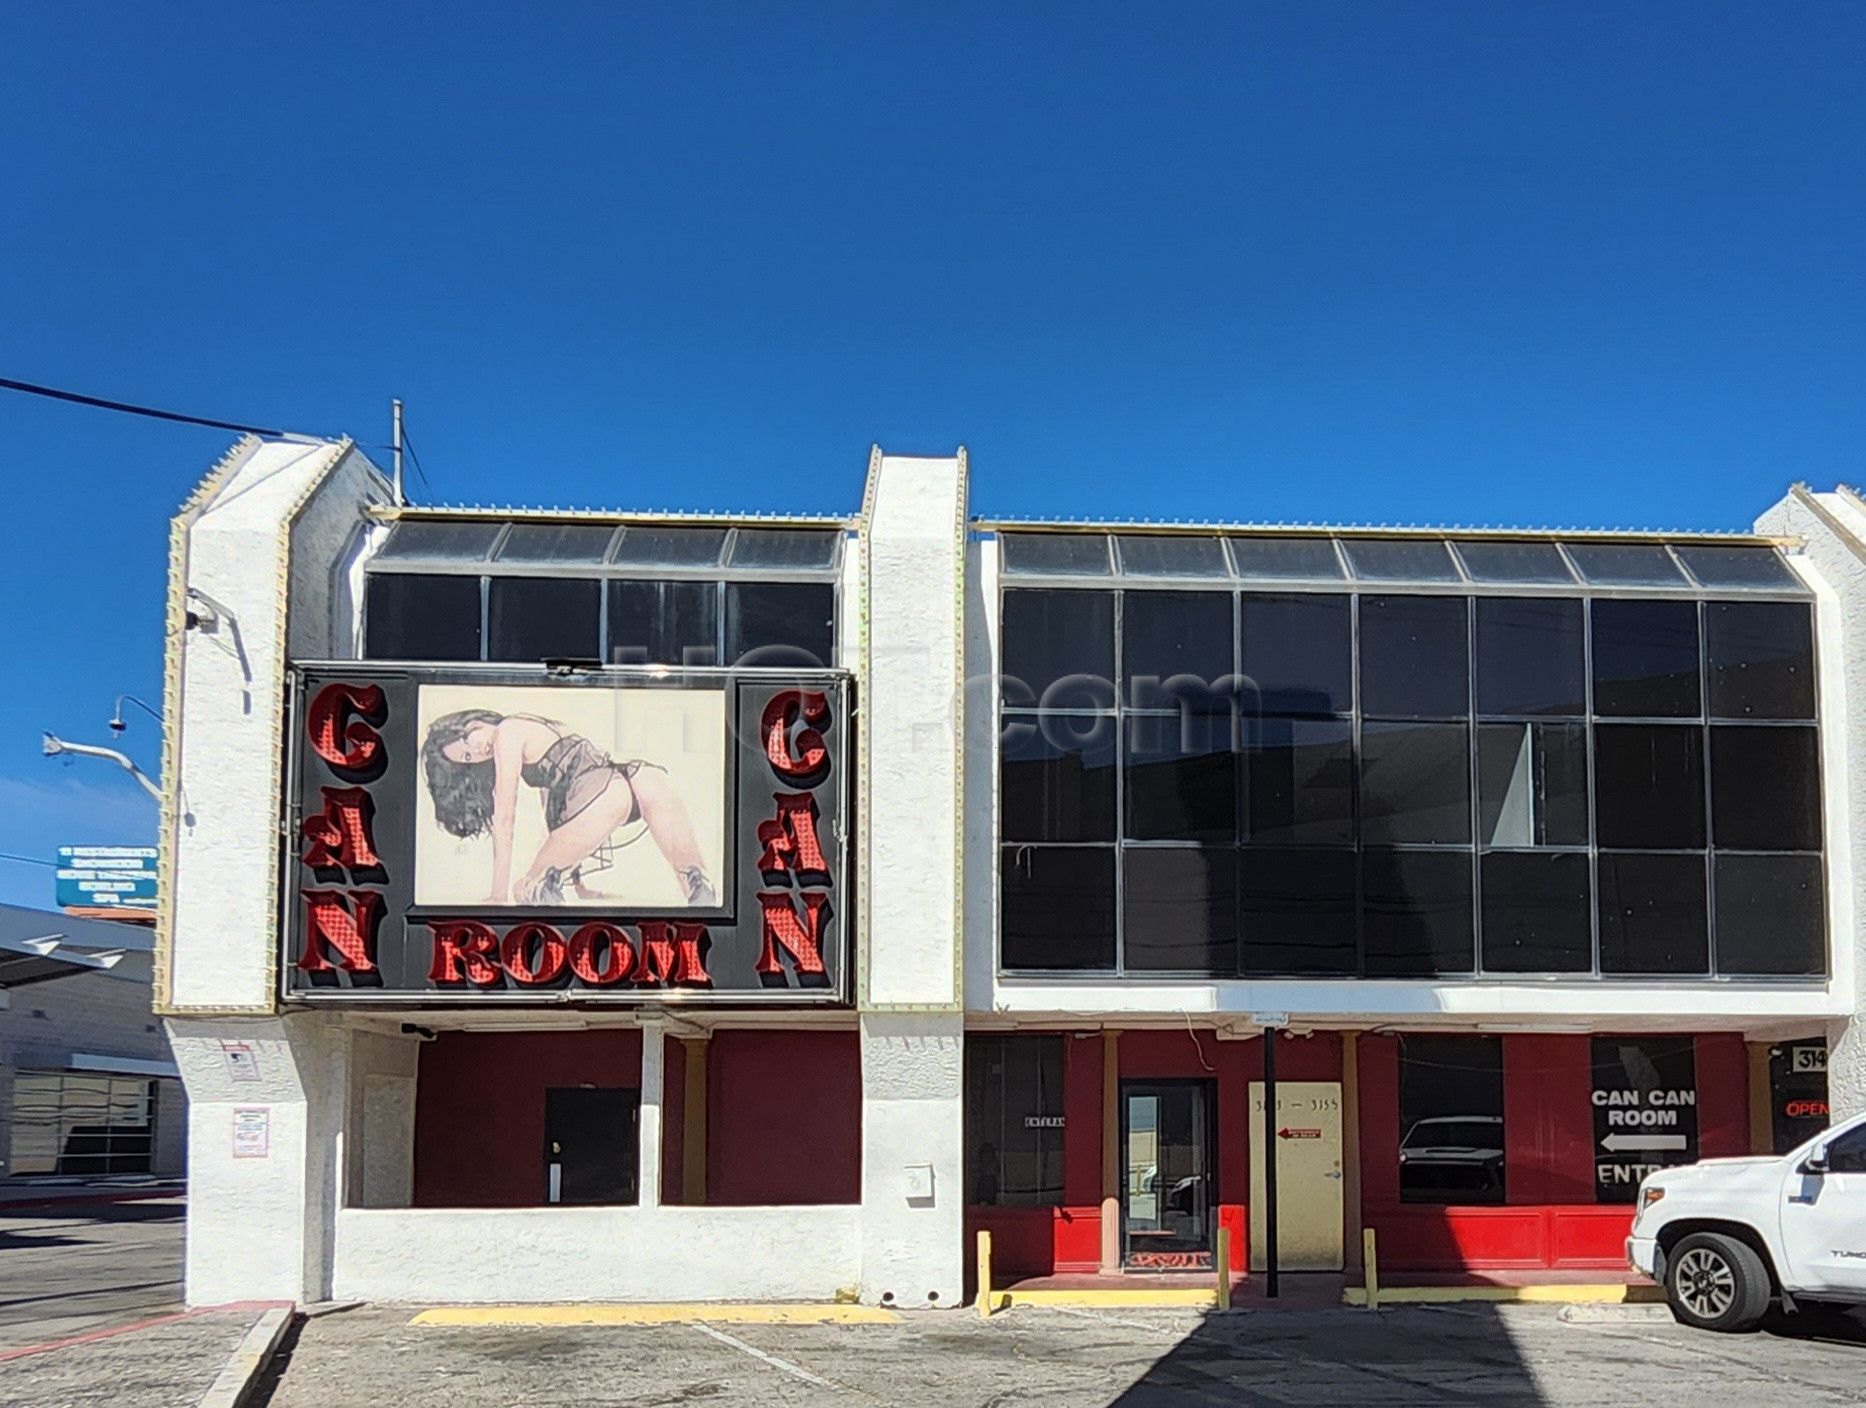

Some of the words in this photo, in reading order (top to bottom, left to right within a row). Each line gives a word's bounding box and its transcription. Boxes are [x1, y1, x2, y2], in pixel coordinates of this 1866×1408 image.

[298, 682, 384, 976] CAN
[756, 687, 830, 976] CAN
[427, 920, 709, 984] ROOM
[1591, 1090, 1639, 1106] CAN
[1648, 1090, 1695, 1106] CAN
[1608, 1110, 1677, 1126] ROOM
[1786, 1103, 1829, 1116] OPEN
